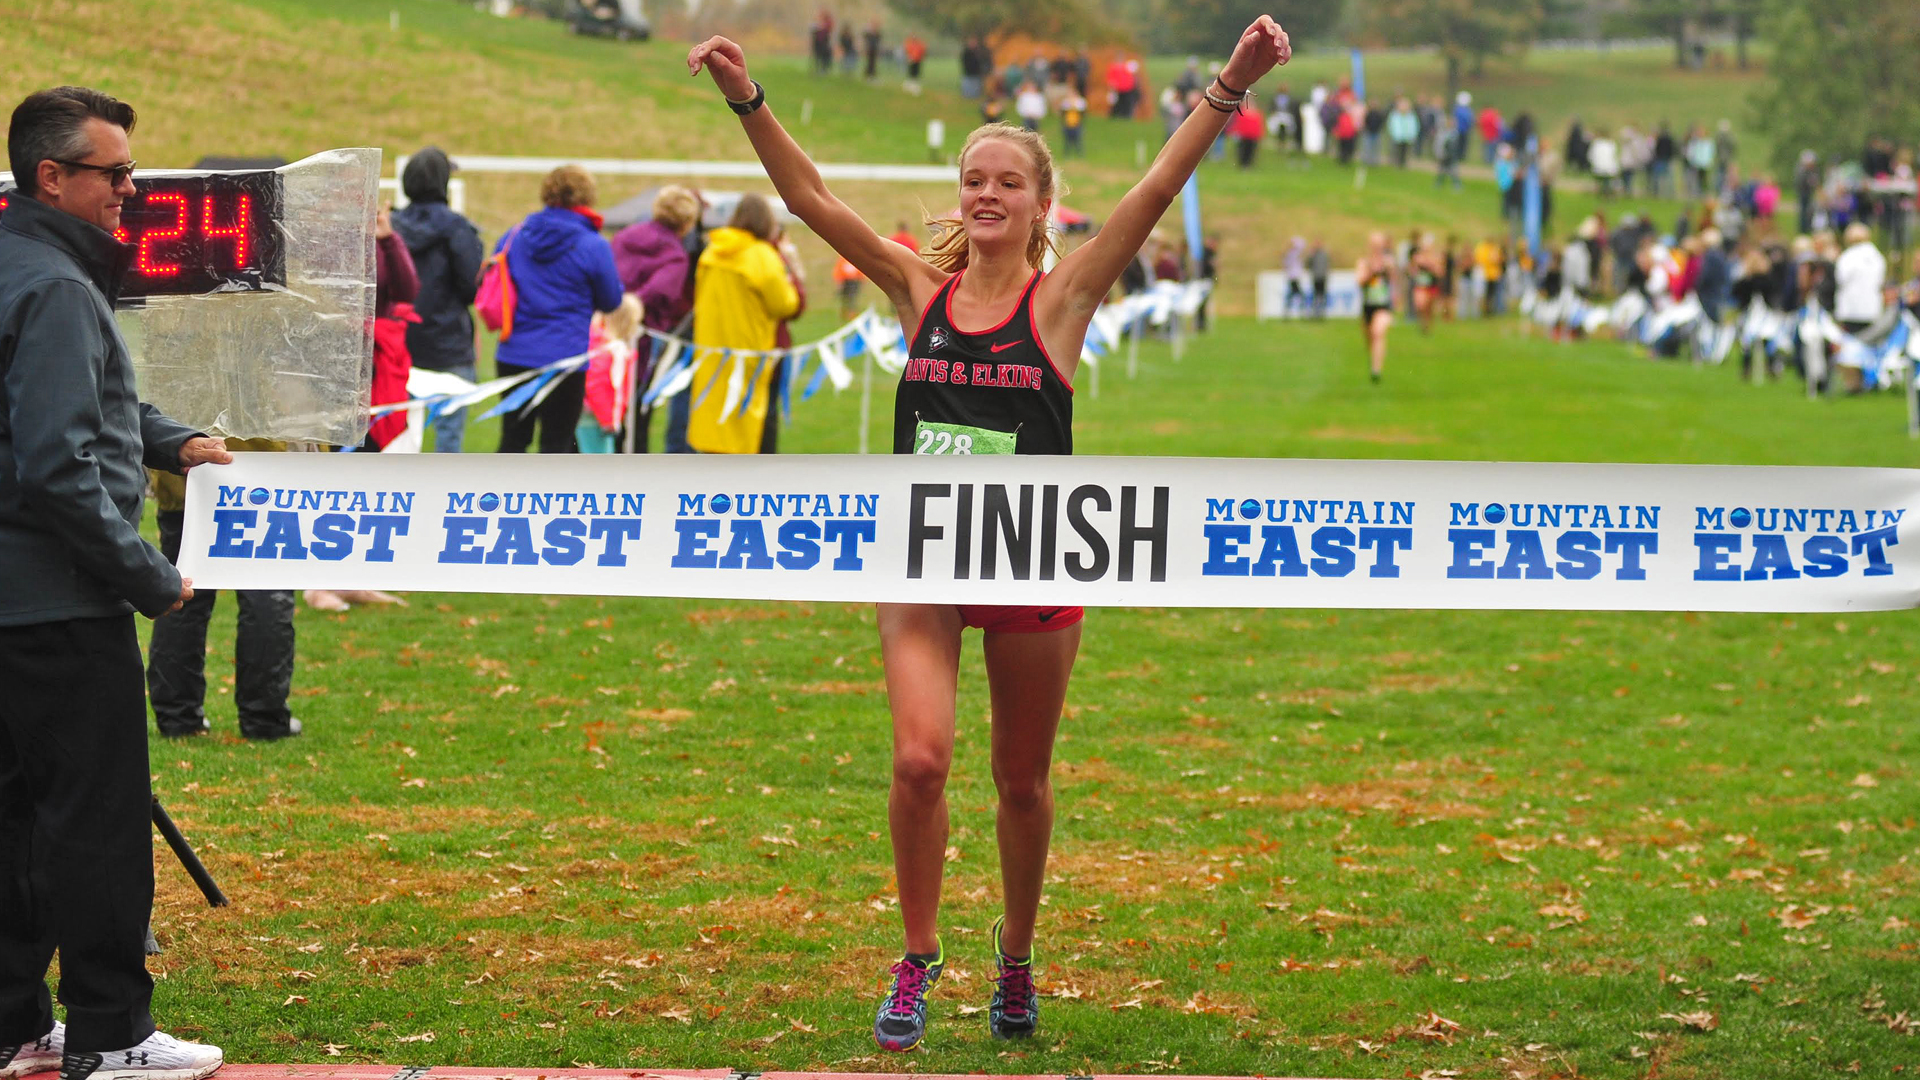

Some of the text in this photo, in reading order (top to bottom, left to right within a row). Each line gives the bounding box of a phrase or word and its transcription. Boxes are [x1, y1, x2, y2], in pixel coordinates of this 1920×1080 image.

[905, 357, 1043, 391] DAVIS & ELKINS
[915, 429, 973, 455] 228
[216, 485, 416, 513] MOUNTAIN
[445, 492, 646, 516] MOUNTAIN
[676, 493, 880, 517] MOUNTAIN
[1205, 497, 1416, 525] MOUNTAIN
[1449, 502, 1662, 530] MOUNTAIN
[207, 509, 411, 563] EAST
[907, 483, 1170, 582] FINISH
[1695, 506, 1907, 534] MOUNTAIN
[437, 516, 642, 567] EAST
[670, 518, 877, 571] EAST
[1202, 523, 1414, 579] EAST
[1446, 528, 1659, 581] EAST
[1693, 524, 1900, 582] EAST
